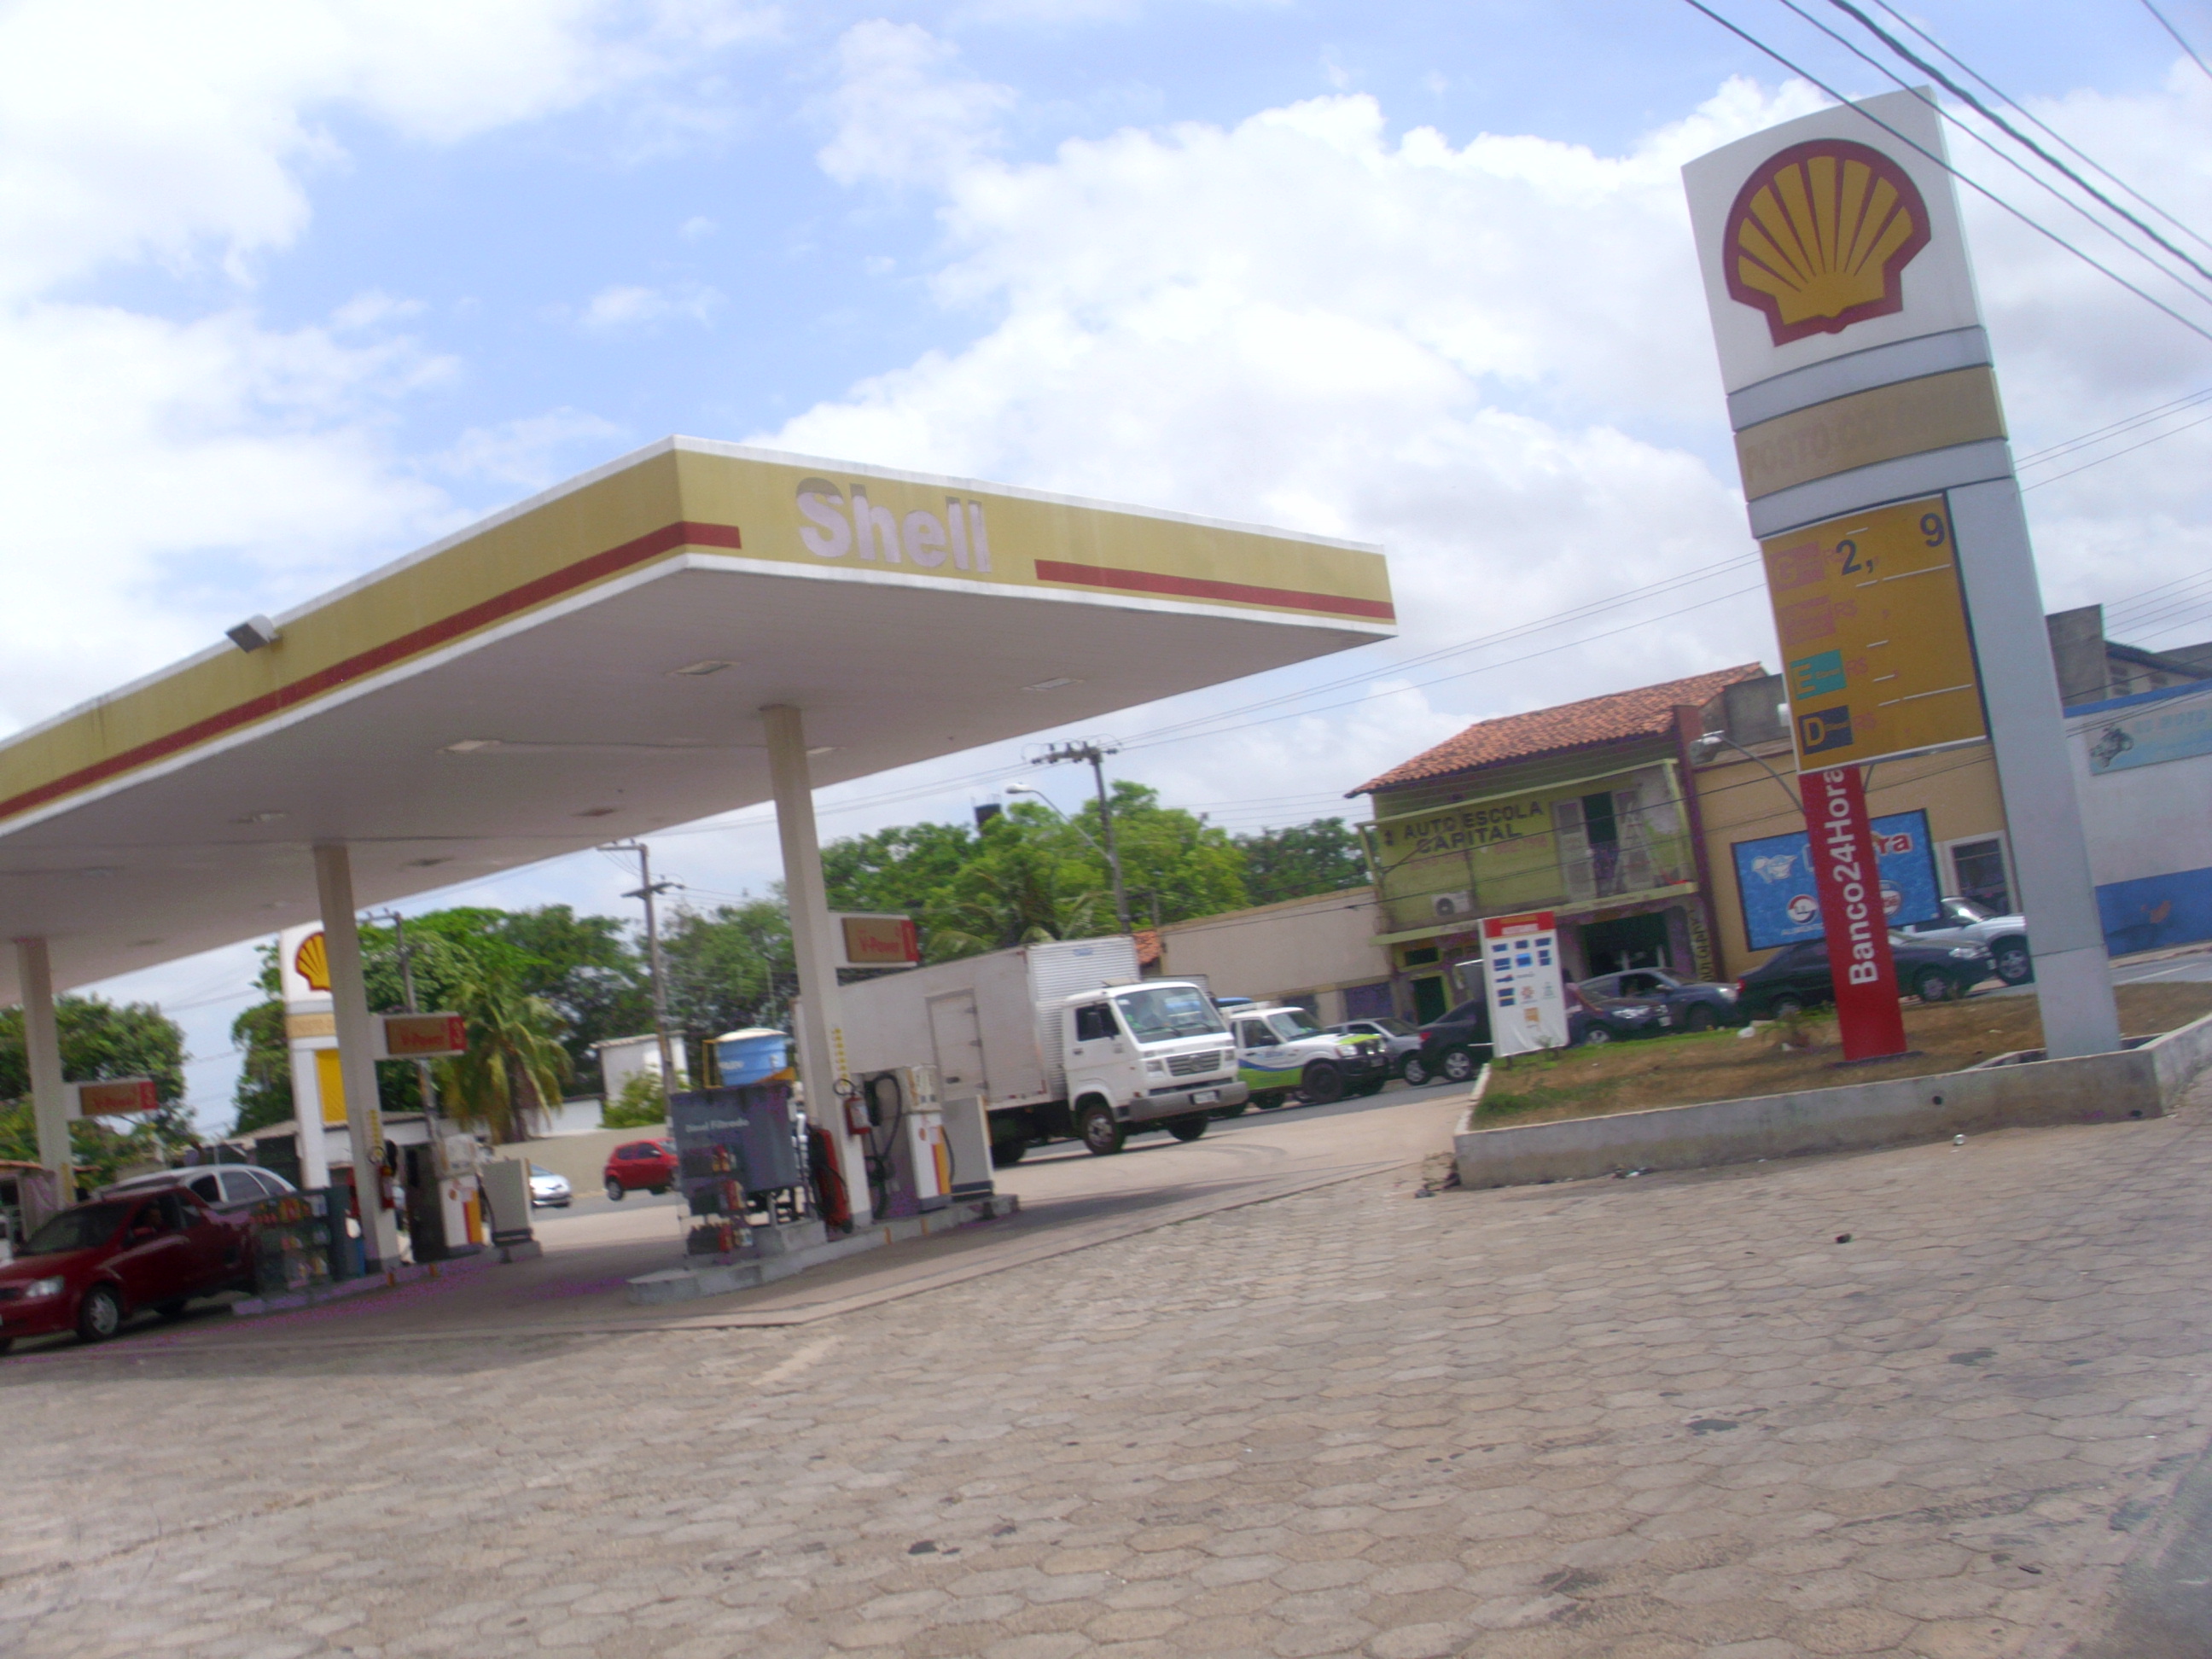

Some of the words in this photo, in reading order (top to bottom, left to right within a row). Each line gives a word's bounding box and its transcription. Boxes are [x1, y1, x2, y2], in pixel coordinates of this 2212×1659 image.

[795, 476, 992, 573] Shell
[1919, 513, 1946, 547] 9
[1792, 662, 1815, 695] E
[1803, 716, 1825, 748] D
[1403, 816, 1455, 839] AUTO
[1461, 800, 1544, 828] ESCOLA
[1416, 823, 1523, 854] CAPITAL
